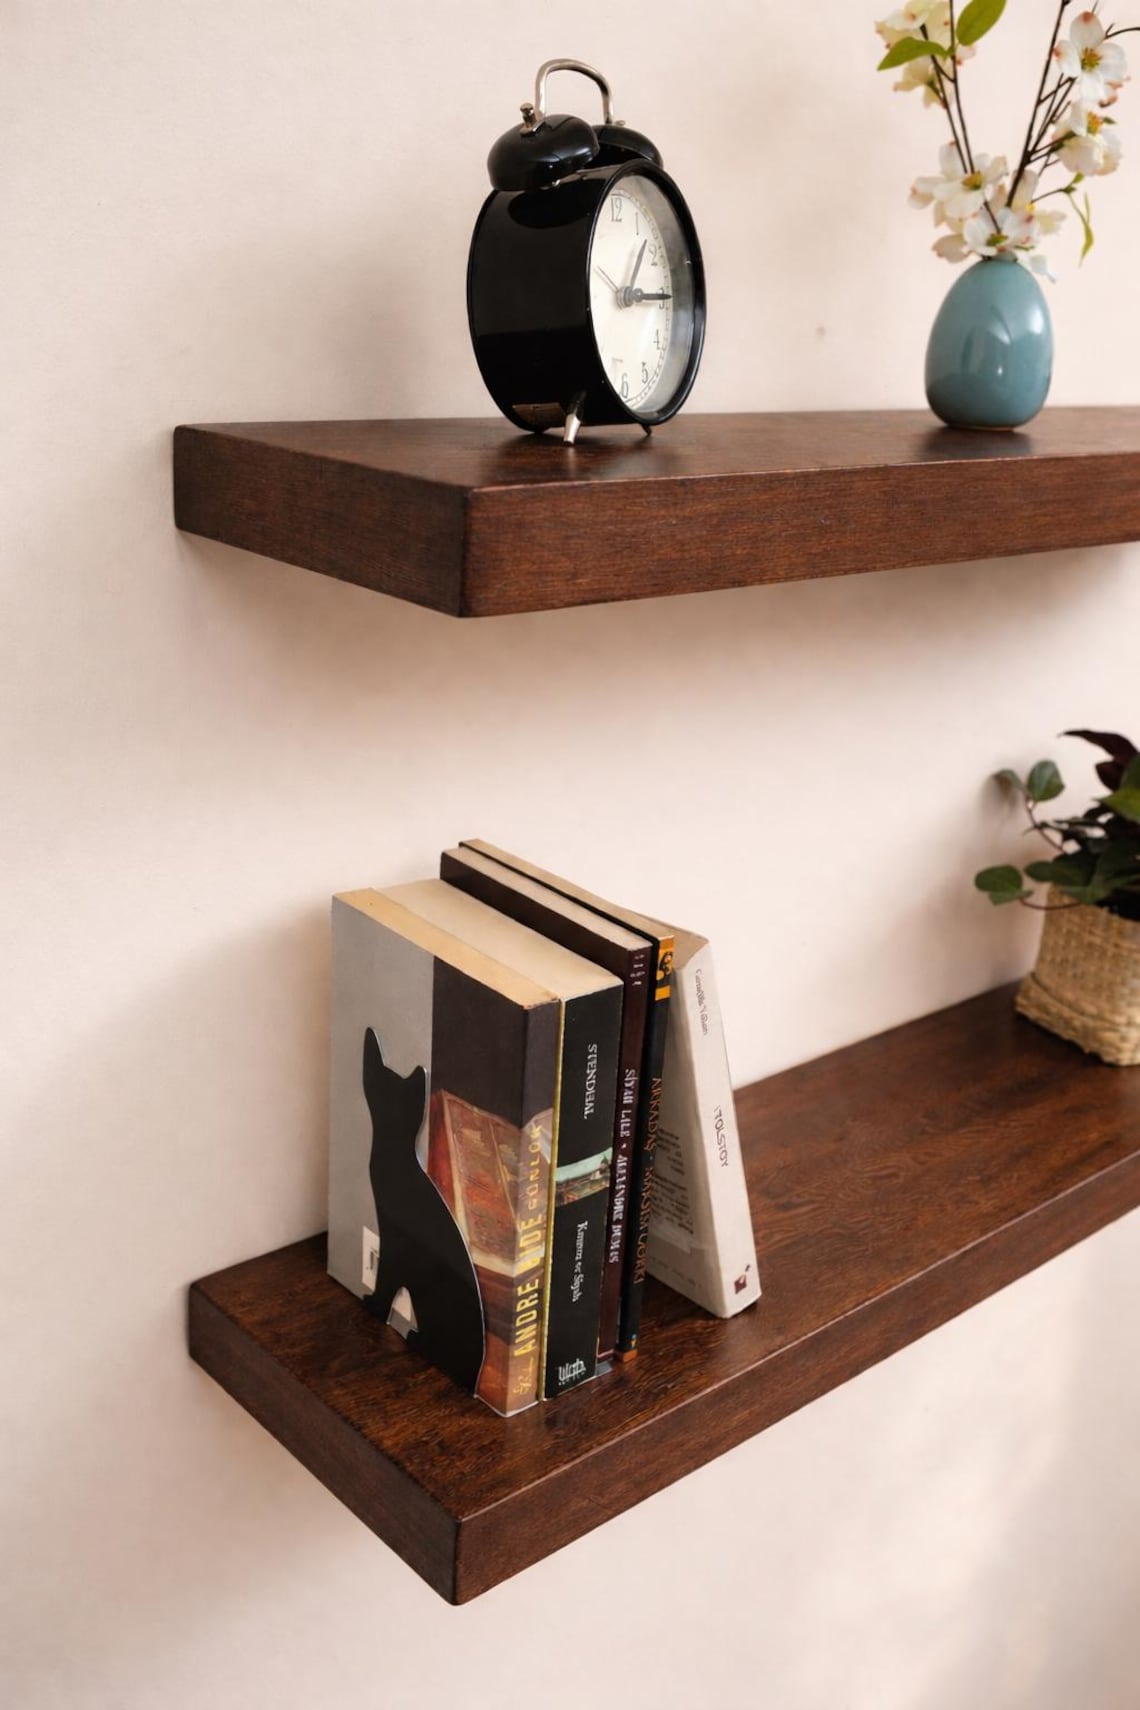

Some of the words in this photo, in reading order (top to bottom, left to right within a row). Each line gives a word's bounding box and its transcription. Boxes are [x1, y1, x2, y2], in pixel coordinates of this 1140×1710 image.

[610, 197, 622, 222] 12
[648, 244, 658, 267] 2
[621, 372, 629, 399] 6
[641, 361, 649, 385] 5
[583, 1043, 598, 1120] STENDHAL
[514, 1278, 539, 1357] ANDRE
